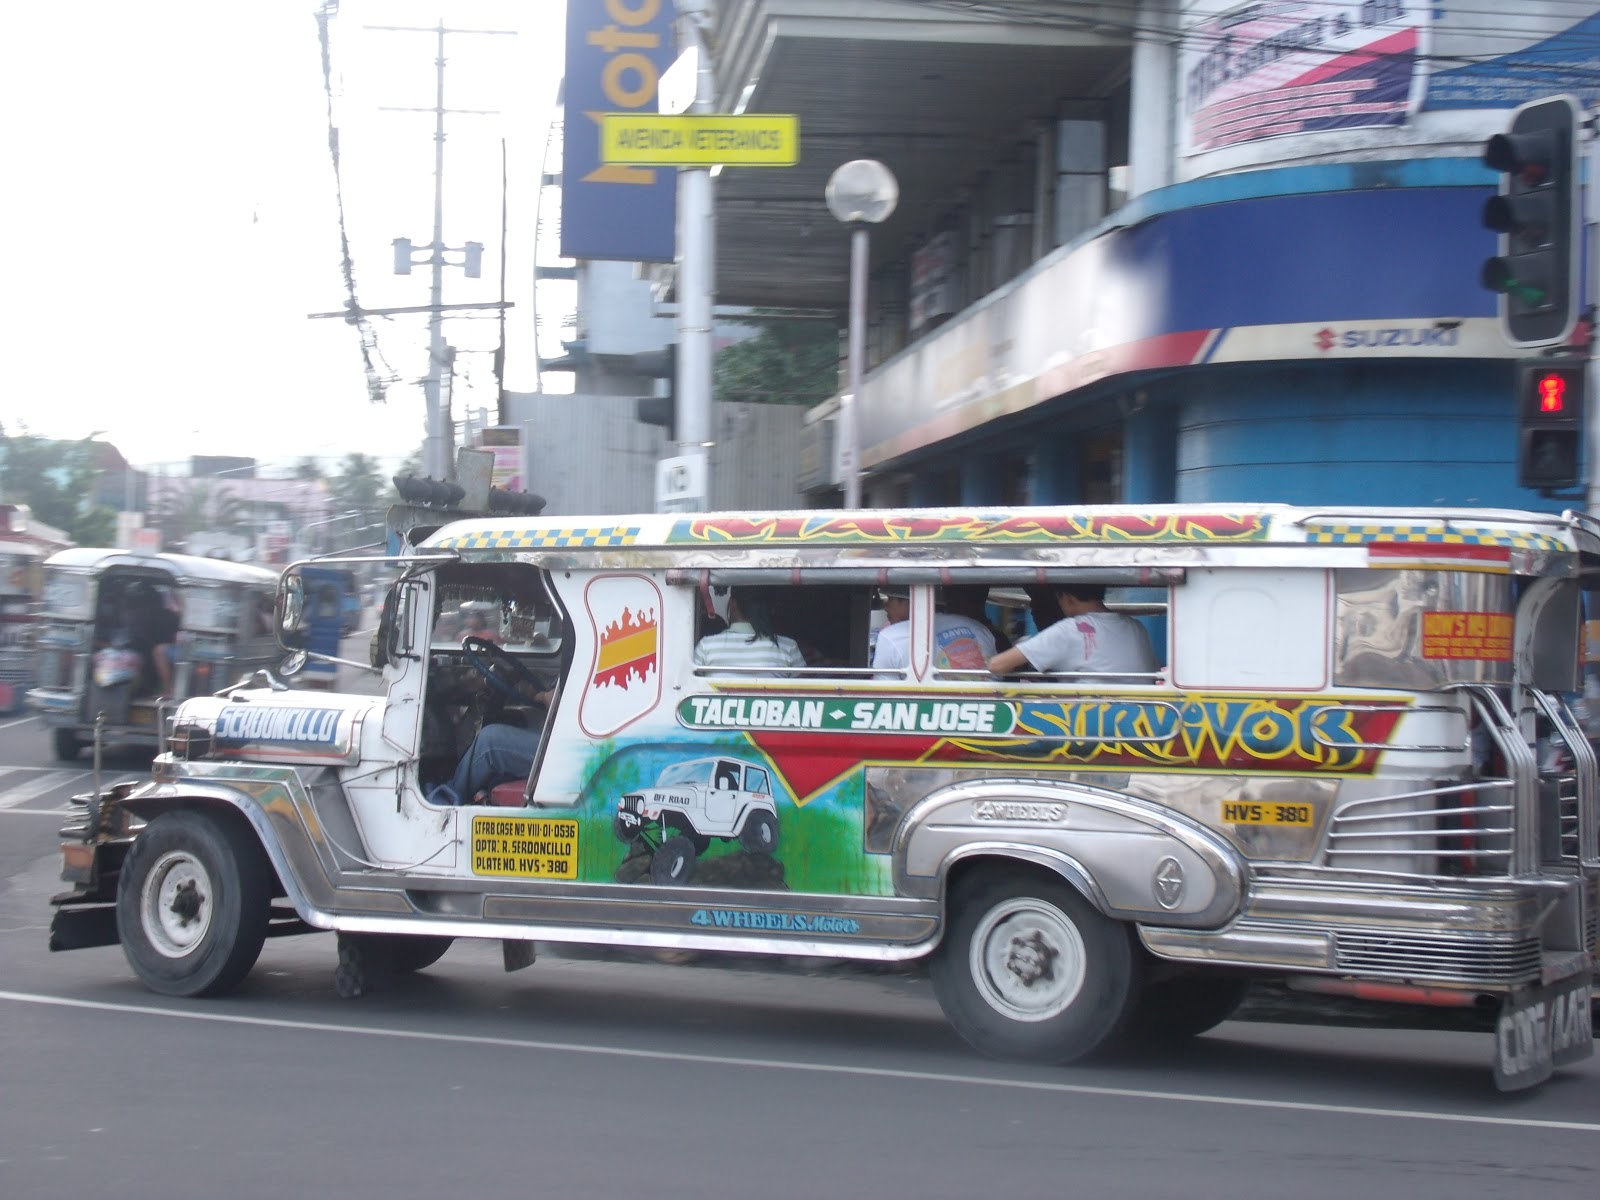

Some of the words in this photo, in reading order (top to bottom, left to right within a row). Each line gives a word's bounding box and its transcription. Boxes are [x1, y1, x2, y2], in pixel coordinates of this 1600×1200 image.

[1341, 327, 1460, 349] SUZUKI
[215, 706, 340, 742] SERDONCILLO
[690, 697, 825, 729] TACLOBAN
[850, 701, 919, 731] SAN
[919, 702, 997, 733] JOSE
[1004, 693, 1365, 770] SURVIVOR
[653, 792, 666, 803] OFF
[668, 794, 690, 806] ROAD
[496, 822, 513, 836] CASE
[502, 840, 511, 854] R.
[511, 841, 572, 856] SERDONCILLO
[476, 856, 502, 871] PLATE
[503, 857, 517, 872] NO.
